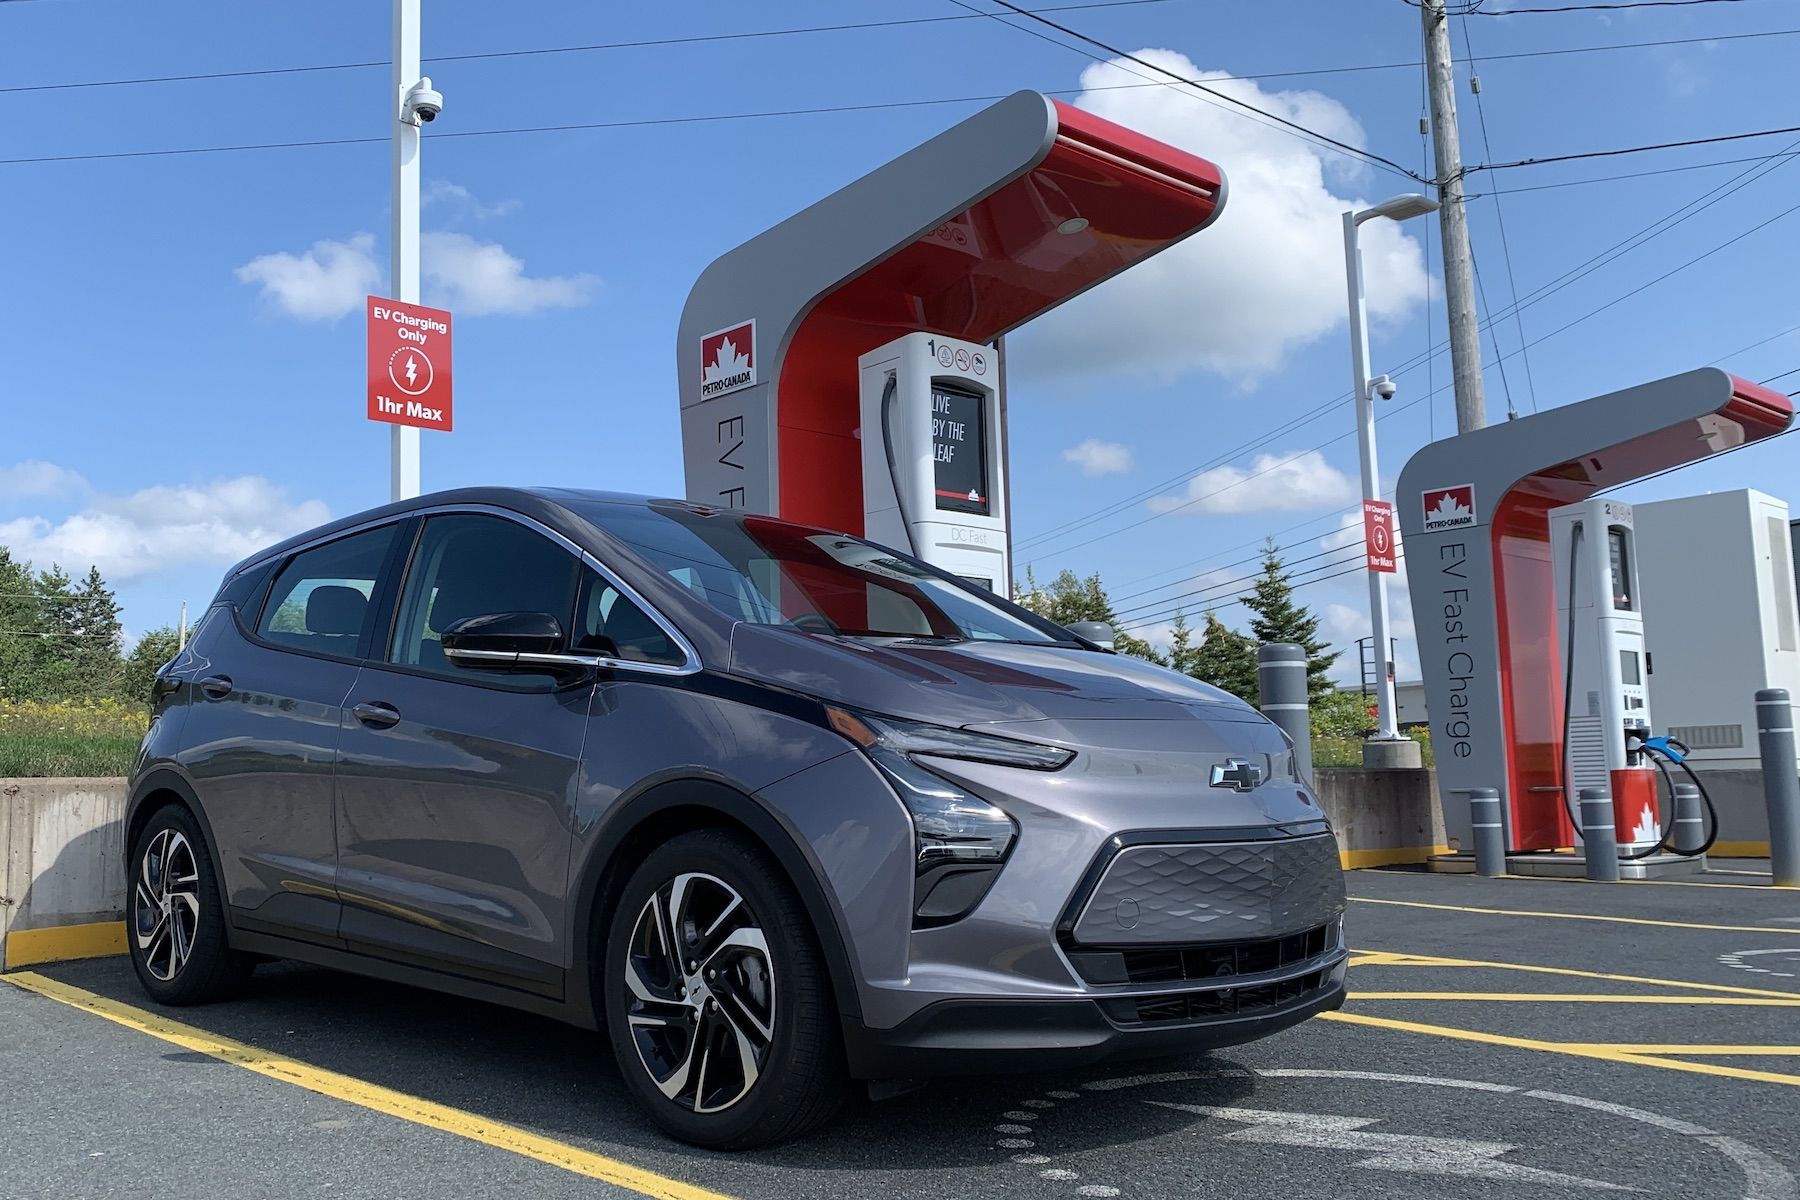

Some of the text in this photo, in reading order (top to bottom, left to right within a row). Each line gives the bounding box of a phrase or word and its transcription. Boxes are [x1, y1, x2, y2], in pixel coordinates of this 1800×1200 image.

[373, 306, 447, 334] EV Charging
[397, 327, 427, 345] Only
[927, 338, 936, 356] 1
[376, 395, 443, 421] 1hr Max
[932, 393, 951, 414] LIVE
[932, 418, 965, 442] BY THE
[718, 415, 745, 509] EV F
[933, 443, 955, 463] LEAF
[1365, 504, 1391, 516] EV Charging
[1605, 503, 1611, 514] 2
[1373, 514, 1385, 523] Only
[951, 528, 987, 544] DC Fast
[1370, 555, 1394, 567] 1hr Max
[1440, 543, 1475, 758] EV Fast Charge
